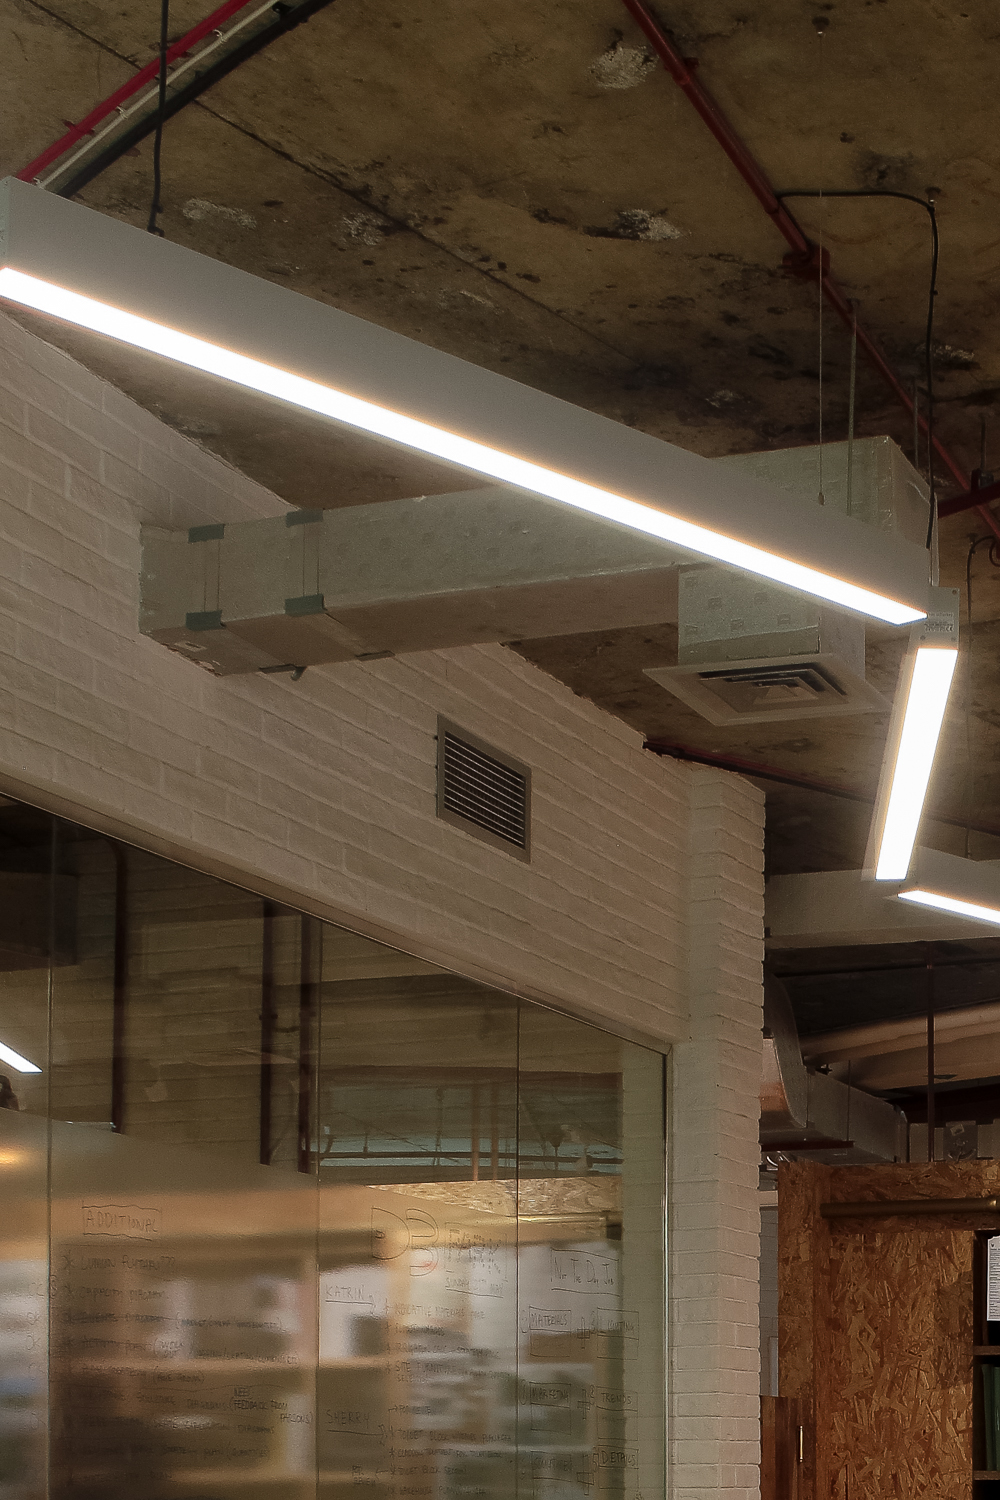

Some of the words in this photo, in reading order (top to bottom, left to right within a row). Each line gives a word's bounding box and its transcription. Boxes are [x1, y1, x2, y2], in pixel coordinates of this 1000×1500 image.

[86, 1211, 158, 1233] ADDITIONAL
[601, 1392, 632, 1404] TRENDS
[601, 1450, 637, 1467] DETAILS
